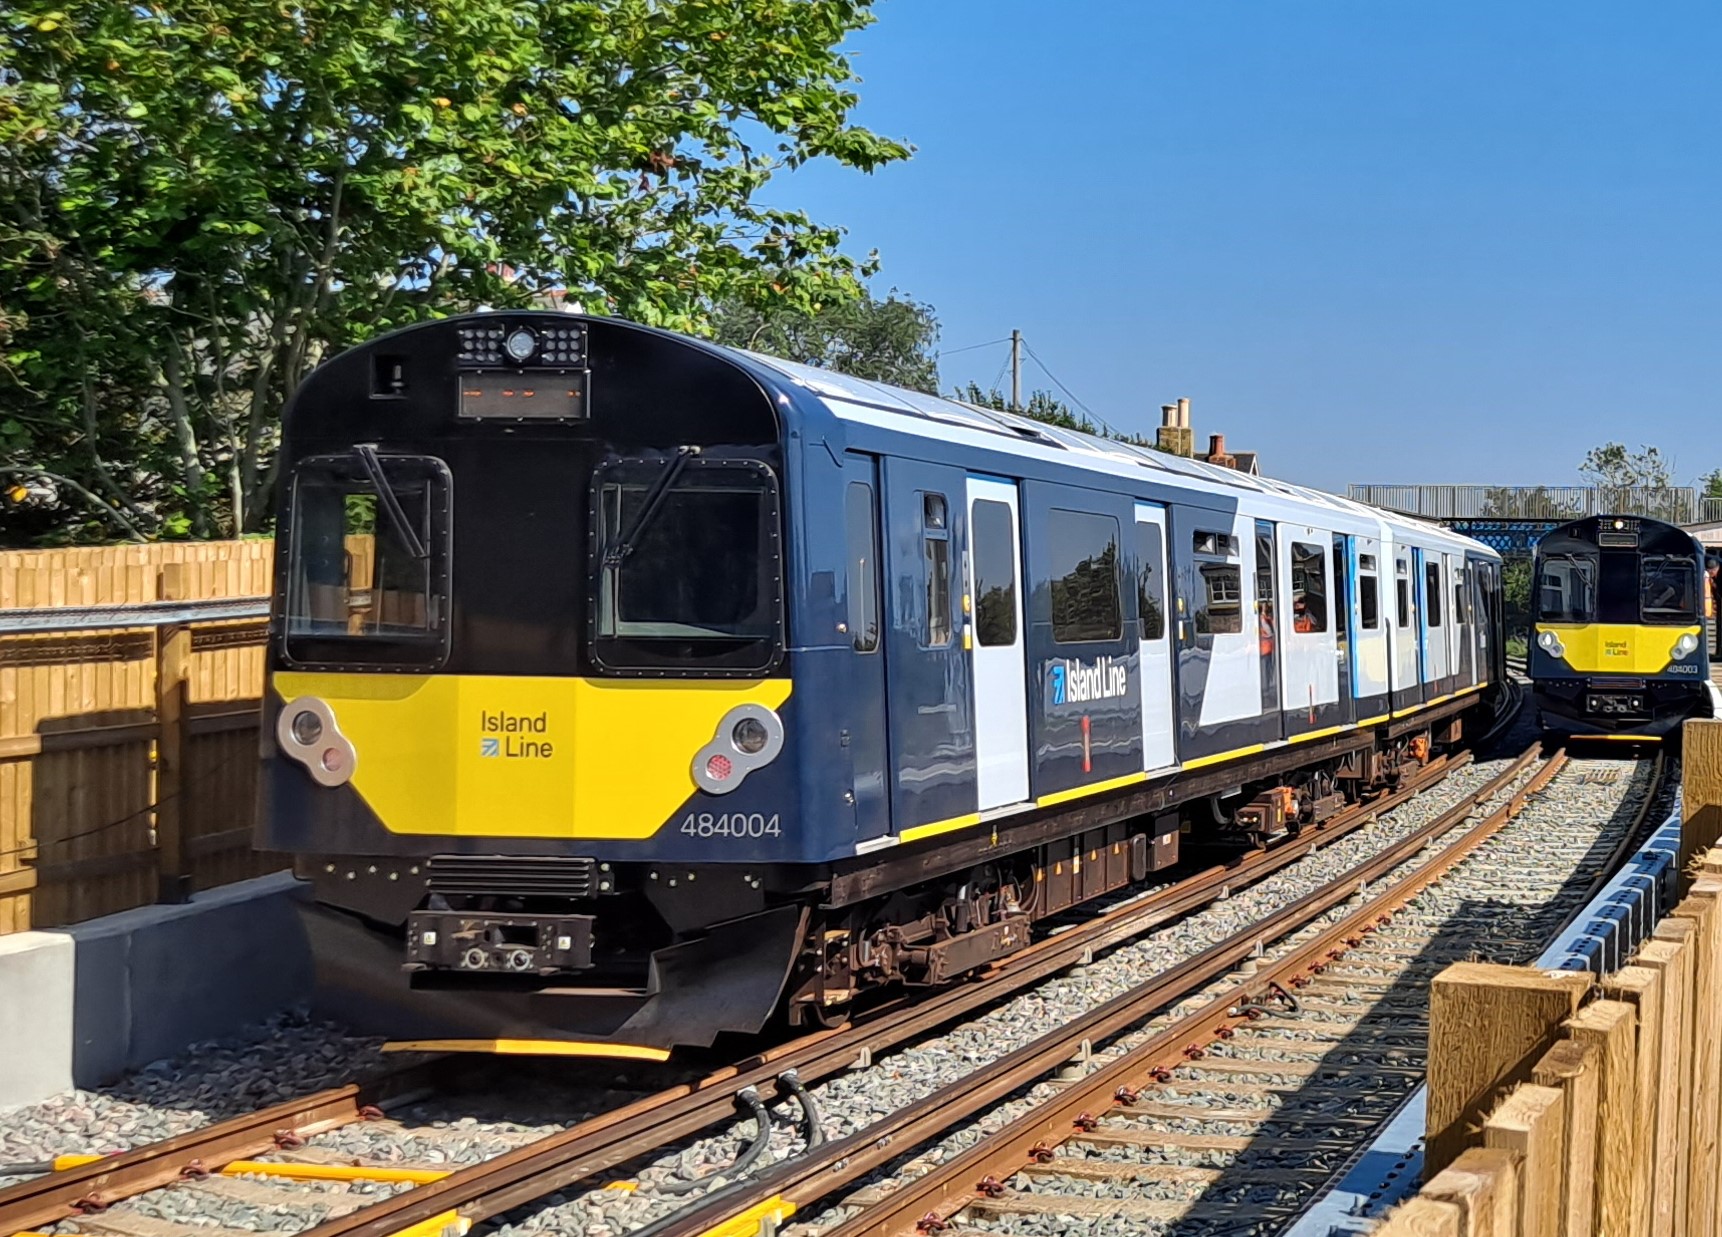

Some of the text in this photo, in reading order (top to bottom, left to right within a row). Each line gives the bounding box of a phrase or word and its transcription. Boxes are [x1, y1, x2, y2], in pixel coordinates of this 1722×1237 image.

[1066, 655, 1126, 702] Island Line
[482, 710, 546, 733] Island
[506, 736, 553, 758] Line
[680, 813, 782, 838] 484004
